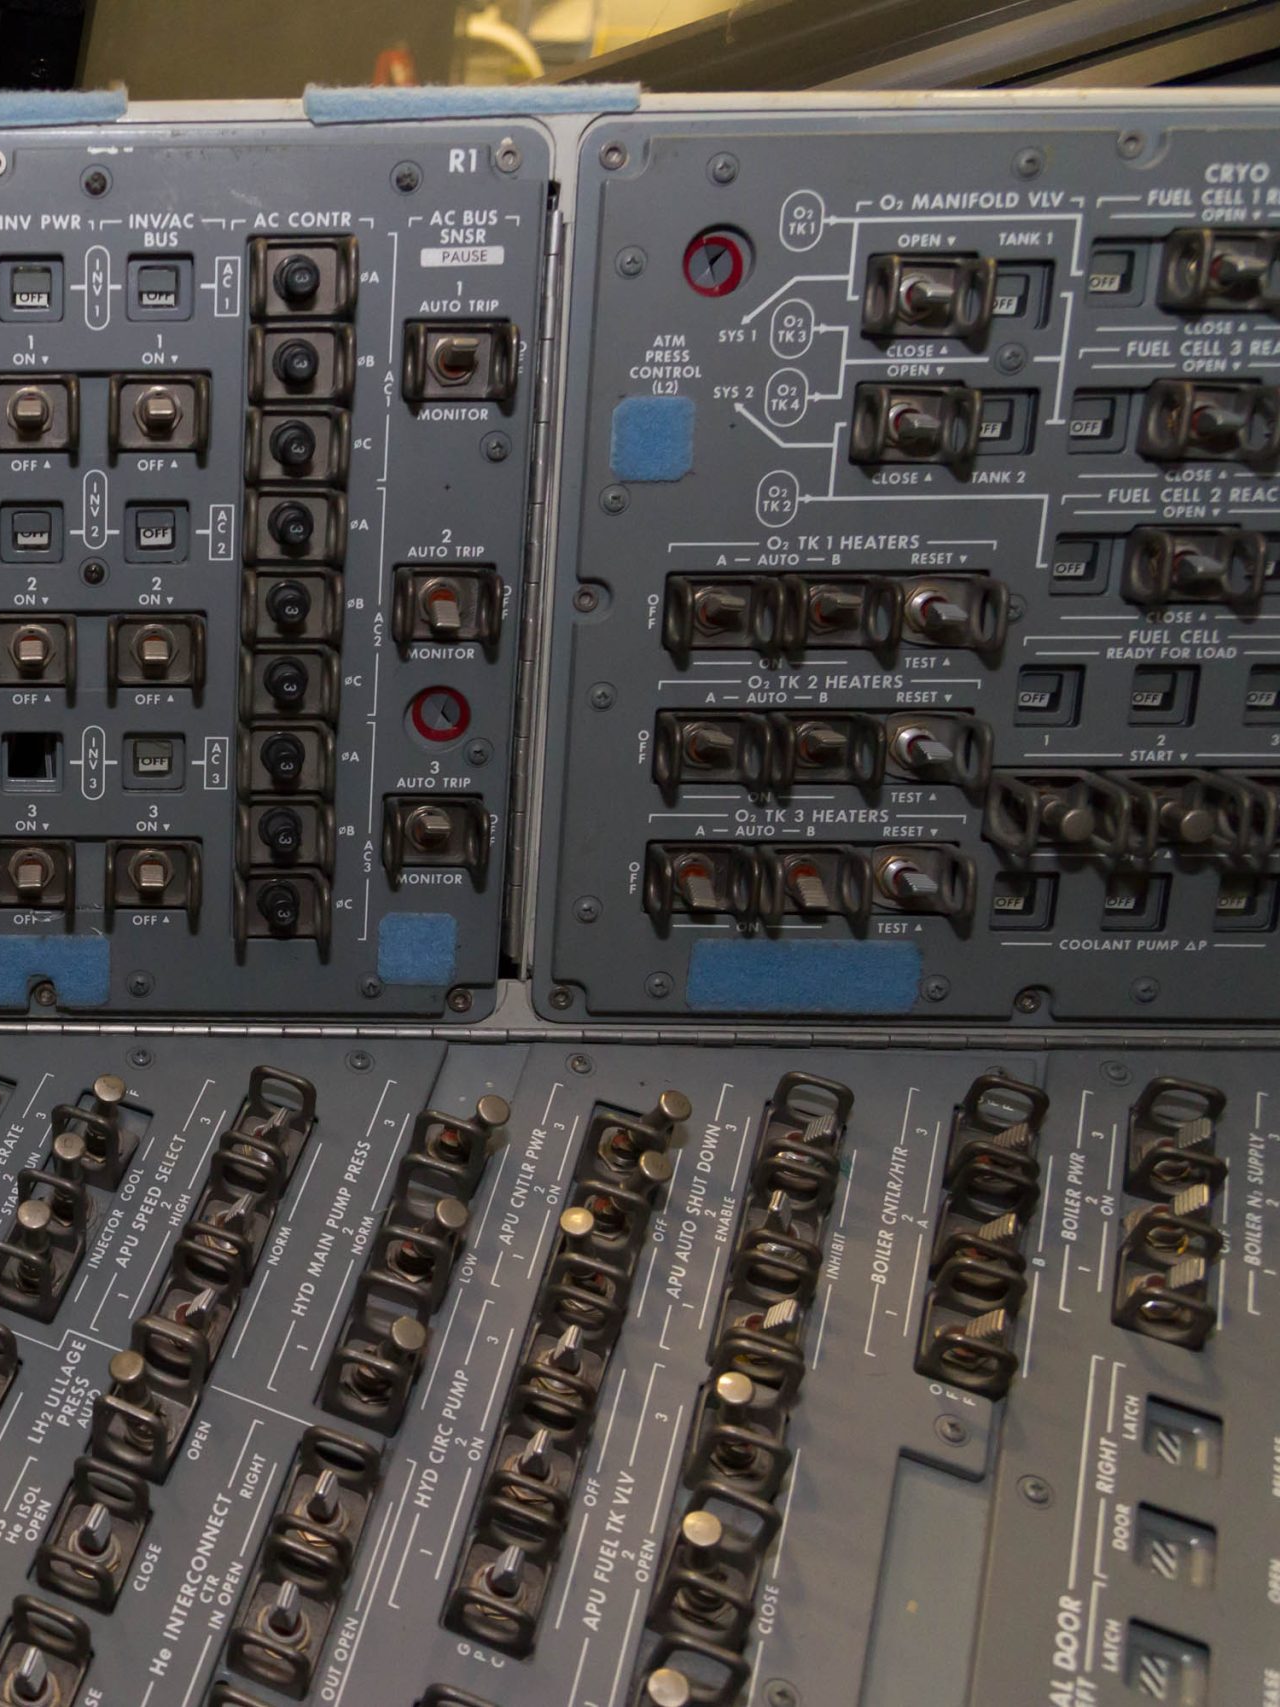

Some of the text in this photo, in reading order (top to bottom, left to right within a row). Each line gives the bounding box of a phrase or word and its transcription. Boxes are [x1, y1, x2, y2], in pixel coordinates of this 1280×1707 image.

[449, 150, 476, 172] R1
[1205, 164, 1269, 183] CRYO
[912, 193, 1019, 209] MANIFOLD
[1029, 192, 1064, 207] VLV
[1148, 189, 1259, 205] FUEL CELL 1
[0, 215, 81, 230] INV PWR
[129, 213, 194, 229] INV/AC
[254, 212, 352, 227] AC CONTR
[430, 210, 498, 226] AC BUS
[144, 233, 178, 247] BUS
[440, 229, 486, 244] SNSR
[442, 250, 488, 263] PAUSE
[420, 300, 499, 312] AUTO TRIP
[653, 335, 685, 347] ATM
[719, 330, 757, 342] SYS 1
[645, 351, 690, 362] PRESS
[630, 366, 701, 379] CONTROL
[652, 381, 678, 395] (L2)
[418, 408, 488, 421] MONITOR
[11, 459, 37, 471] OFF
[1108, 489, 1151, 503] FUEL
[1161, 489, 1200, 503] CELL
[1210, 488, 1221, 502] 2
[799, 537, 819, 550] TK
[827, 536, 832, 549] 1
[840, 535, 919, 549] HEATERS
[911, 553, 952, 564] RESET
[1129, 631, 1221, 645] FUEL CELL
[1106, 648, 1237, 660] READY FOR LOAD
[1130, 750, 1173, 761] START
[765, 810, 786, 822] TK
[794, 810, 804, 822] 3
[812, 810, 889, 822] HEATERS
[132, 915, 157, 925] OFF
[1060, 940, 1130, 951] COOLANT
[1137, 940, 1179, 951] PUMP
[1248, 1134, 1265, 1185] SUPPLY
[499, 1128, 547, 1245] APU CNTLR PWR
[115, 1134, 187, 1269] APU SPEED SELECT
[1061, 1152, 1085, 1241] BOILER PWR
[168, 1193, 191, 1228] HIGH
[665, 1123, 721, 1299] APU AUTO SHUT DOWN
[871, 1145, 910, 1284] BOILER CNTLR/HTR
[87, 1168, 144, 1270] INJECTOR COOL
[715, 1196, 736, 1243] ENABLE
[291, 1140, 371, 1318] HYD MAIN PUMP PRESS
[1243, 1212, 1264, 1266] BOILER
[826, 1232, 846, 1280] INHIBIT
[27, 1339, 87, 1444] LH2 ULLAGE
[1122, 1395, 1140, 1440] LATCH
[1095, 1437, 1118, 1494] RIGHT
[5, 1485, 41, 1545] He ISOL
[581, 1471, 635, 1632] APU FUEL TK VLV
[133, 1544, 162, 1592] CLOSE
[149, 1492, 232, 1676] He INTERCONNECT
[1053, 1596, 1082, 1670] DOOR
[322, 1616, 358, 1700] OUT OPEN
